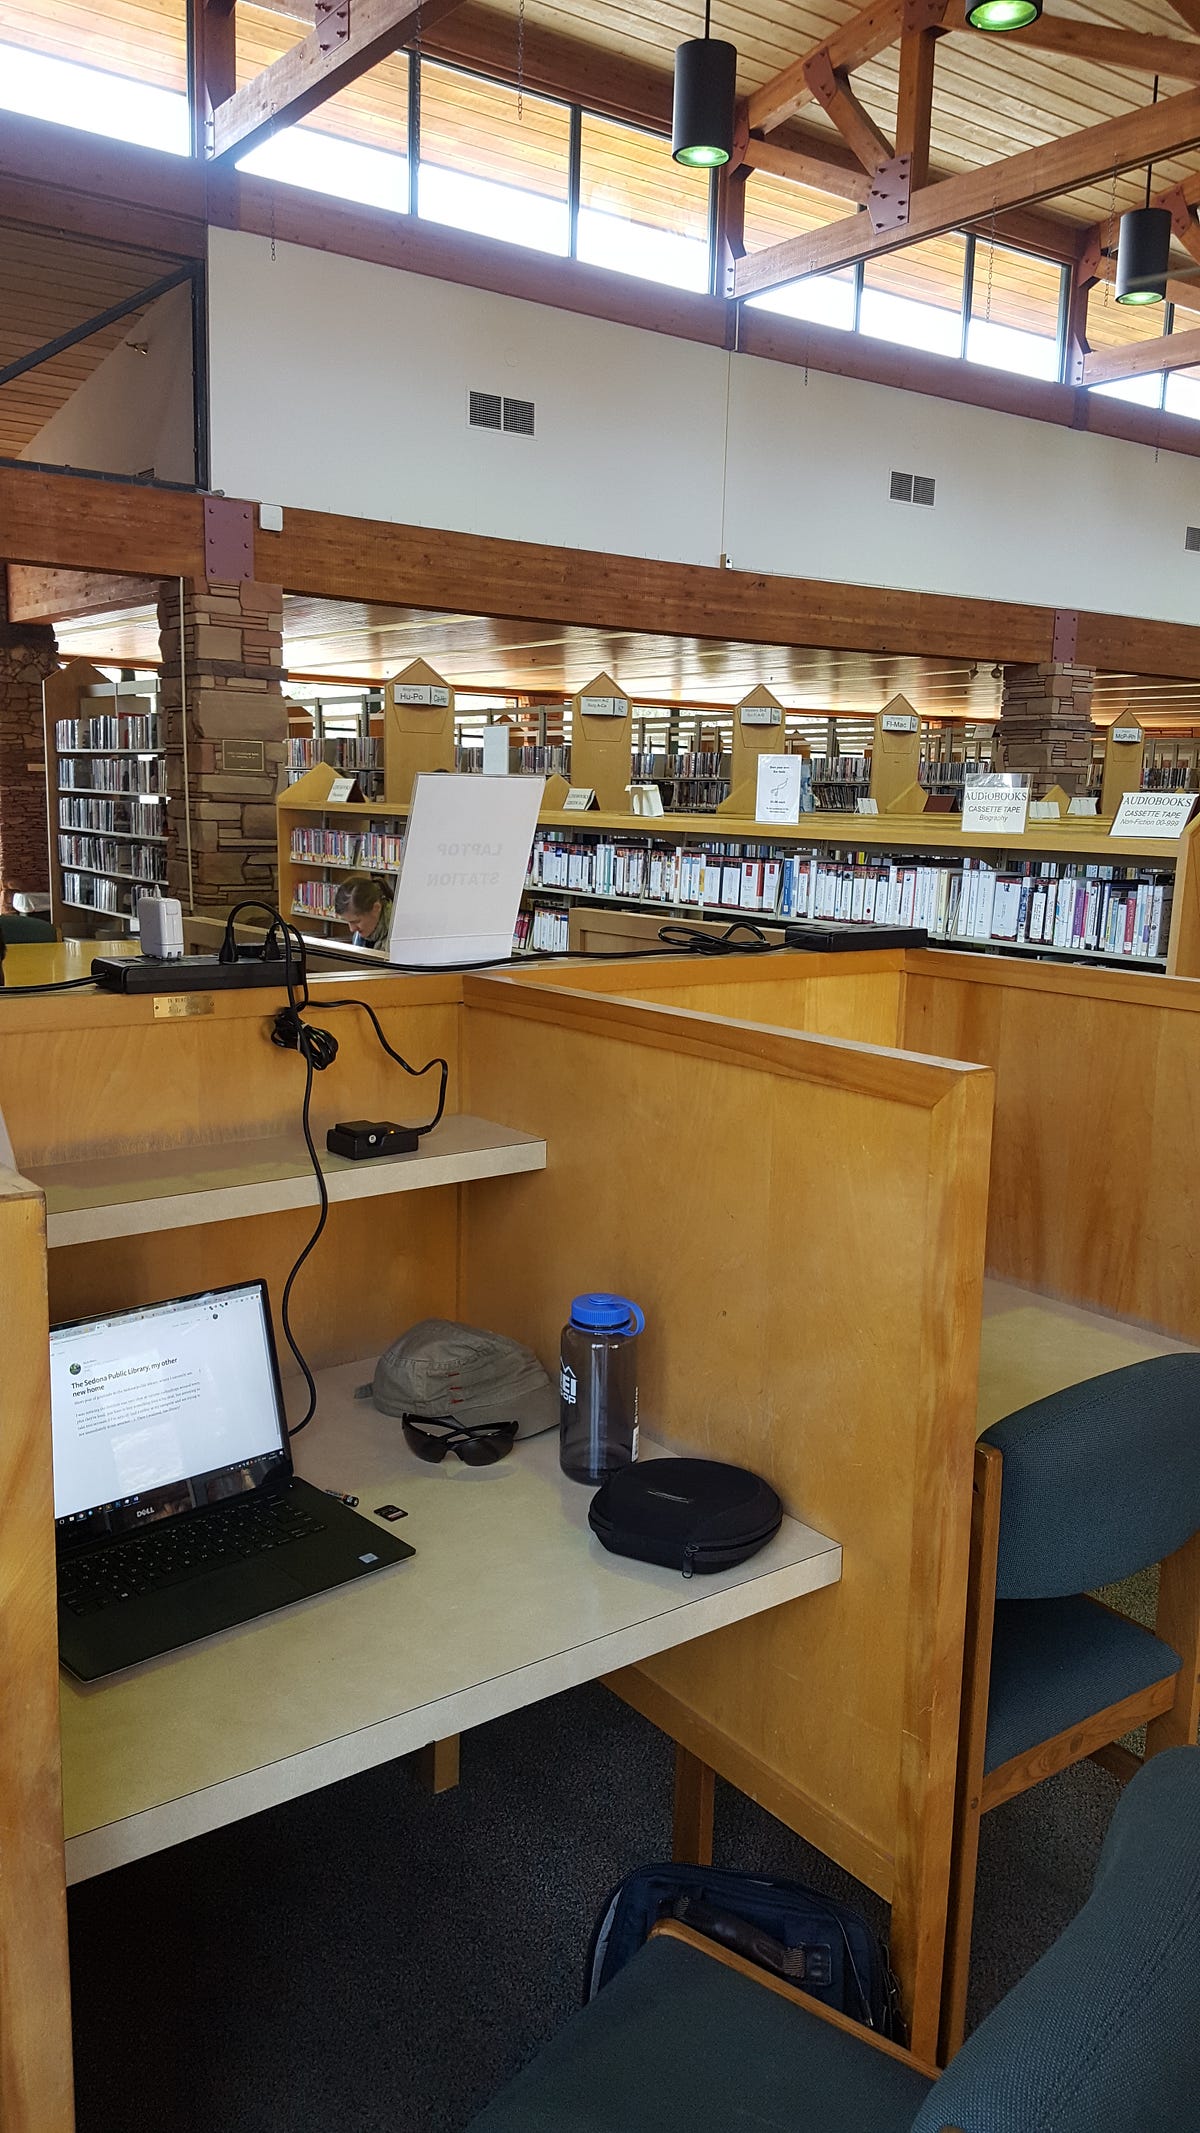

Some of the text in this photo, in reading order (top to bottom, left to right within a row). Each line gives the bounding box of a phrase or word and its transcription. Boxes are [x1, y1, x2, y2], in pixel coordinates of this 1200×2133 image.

[400, 692, 424, 701] Hu-Po
[965, 791, 1028, 801] AUDIOBOOKS
[1122, 796, 1193, 808] AUDIOBOOKS
[968, 805, 1022, 814] CASSETTE TAPE
[1124, 809, 1183, 819] CASSETTE TAPE
[1119, 818, 1155, 826] Non-Fiction
[71, 1357, 178, 1390] The Sedona Public Library, my other
[72, 1384, 105, 1398] new home
[136, 1506, 155, 1518] DELL
